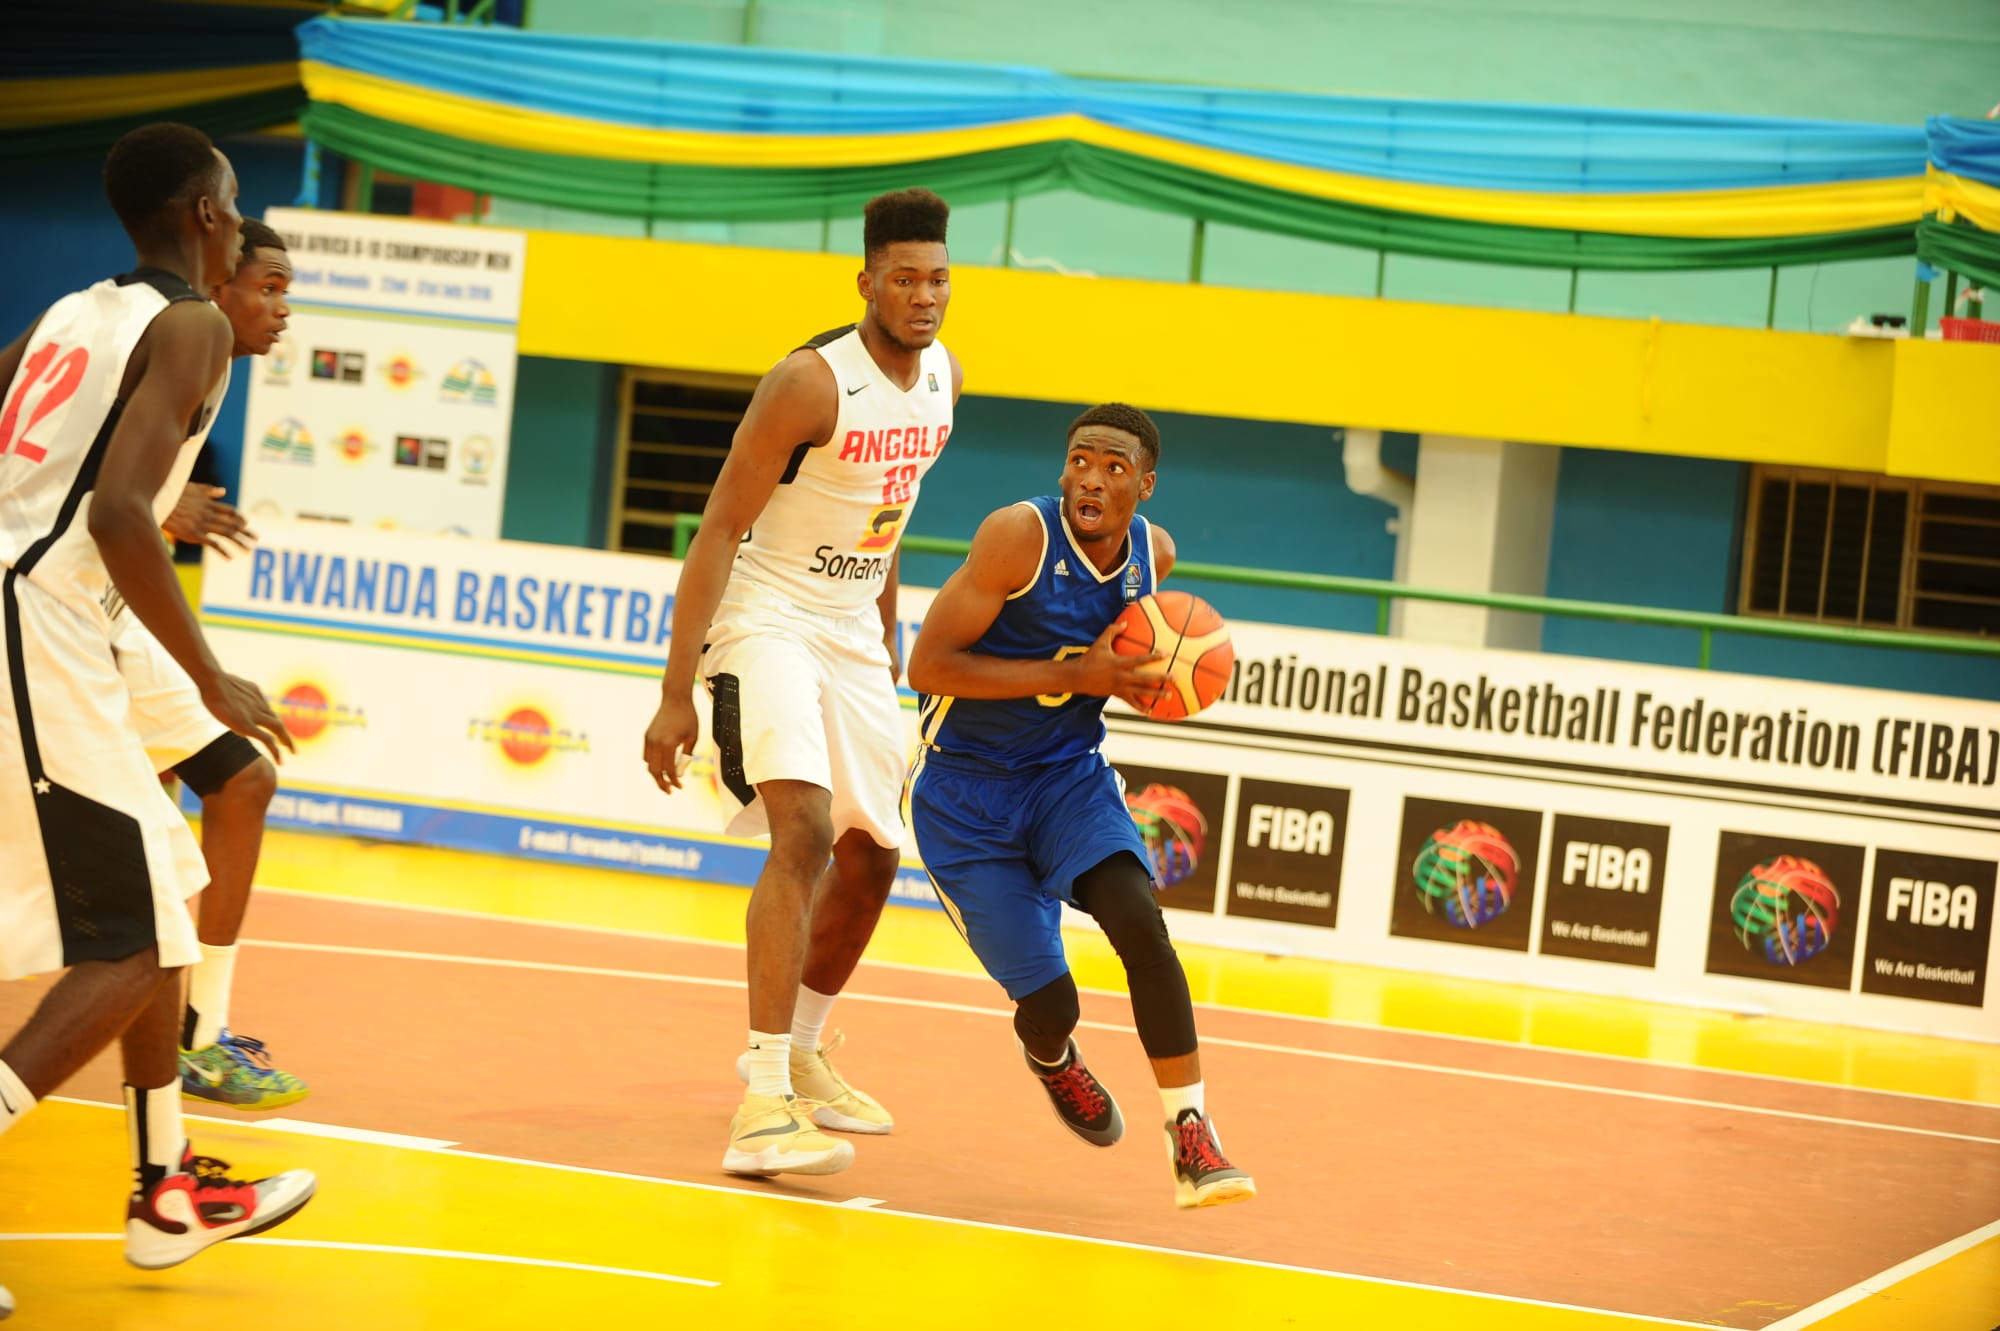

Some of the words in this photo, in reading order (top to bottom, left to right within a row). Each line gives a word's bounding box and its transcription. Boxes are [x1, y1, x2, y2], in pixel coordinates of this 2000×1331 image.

[0, 341, 89, 464] 12
[838, 424, 949, 463] ANGOLA
[250, 548, 438, 619] RWANDA
[808, 545, 888, 582] Sonan
[1398, 667, 1621, 745] Basketball
[1629, 692, 1860, 771] Federation
[1872, 718, 2000, 787] (FIBA)
[1247, 804, 1334, 856] FIBA
[1562, 840, 1652, 894] FIBA
[1886, 877, 1977, 931] FIBA
[1875, 958, 1893, 975] We
[1895, 961, 1915, 978] Are
[1916, 963, 1975, 985] Basketball
